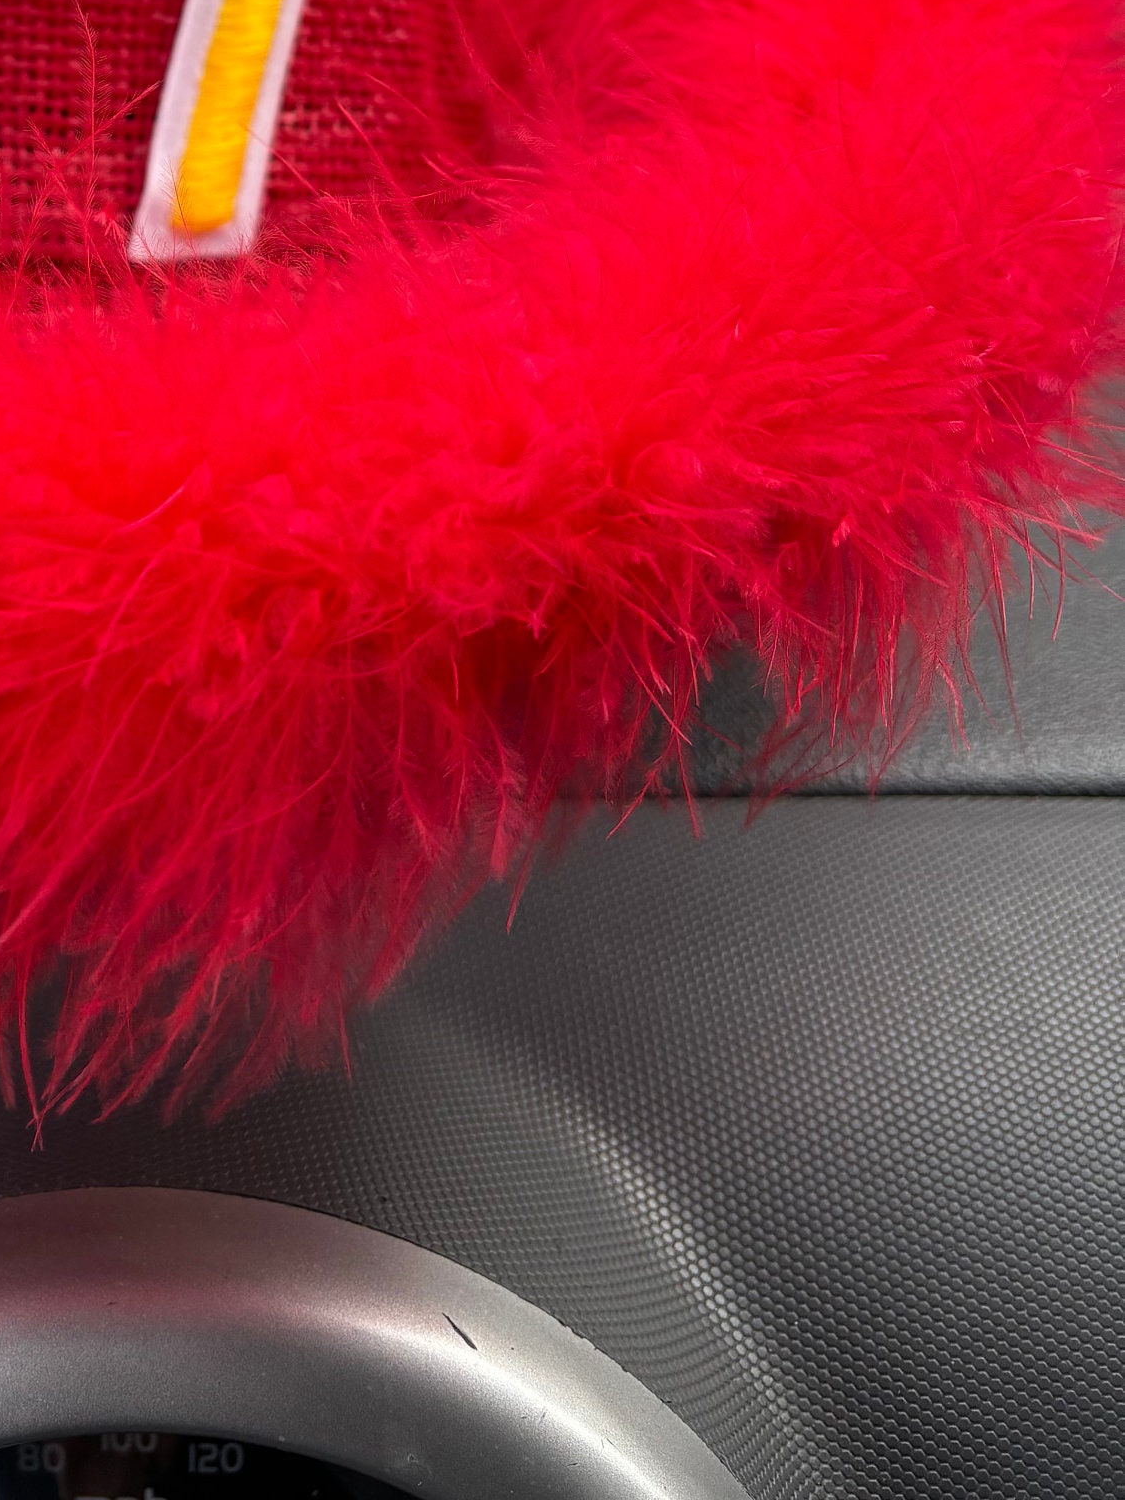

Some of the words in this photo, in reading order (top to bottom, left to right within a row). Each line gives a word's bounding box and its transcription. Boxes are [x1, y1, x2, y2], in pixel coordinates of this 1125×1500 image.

[16, 1442, 68, 1473] 80
[100, 1432, 158, 1453] 100
[187, 1442, 245, 1474] 120
